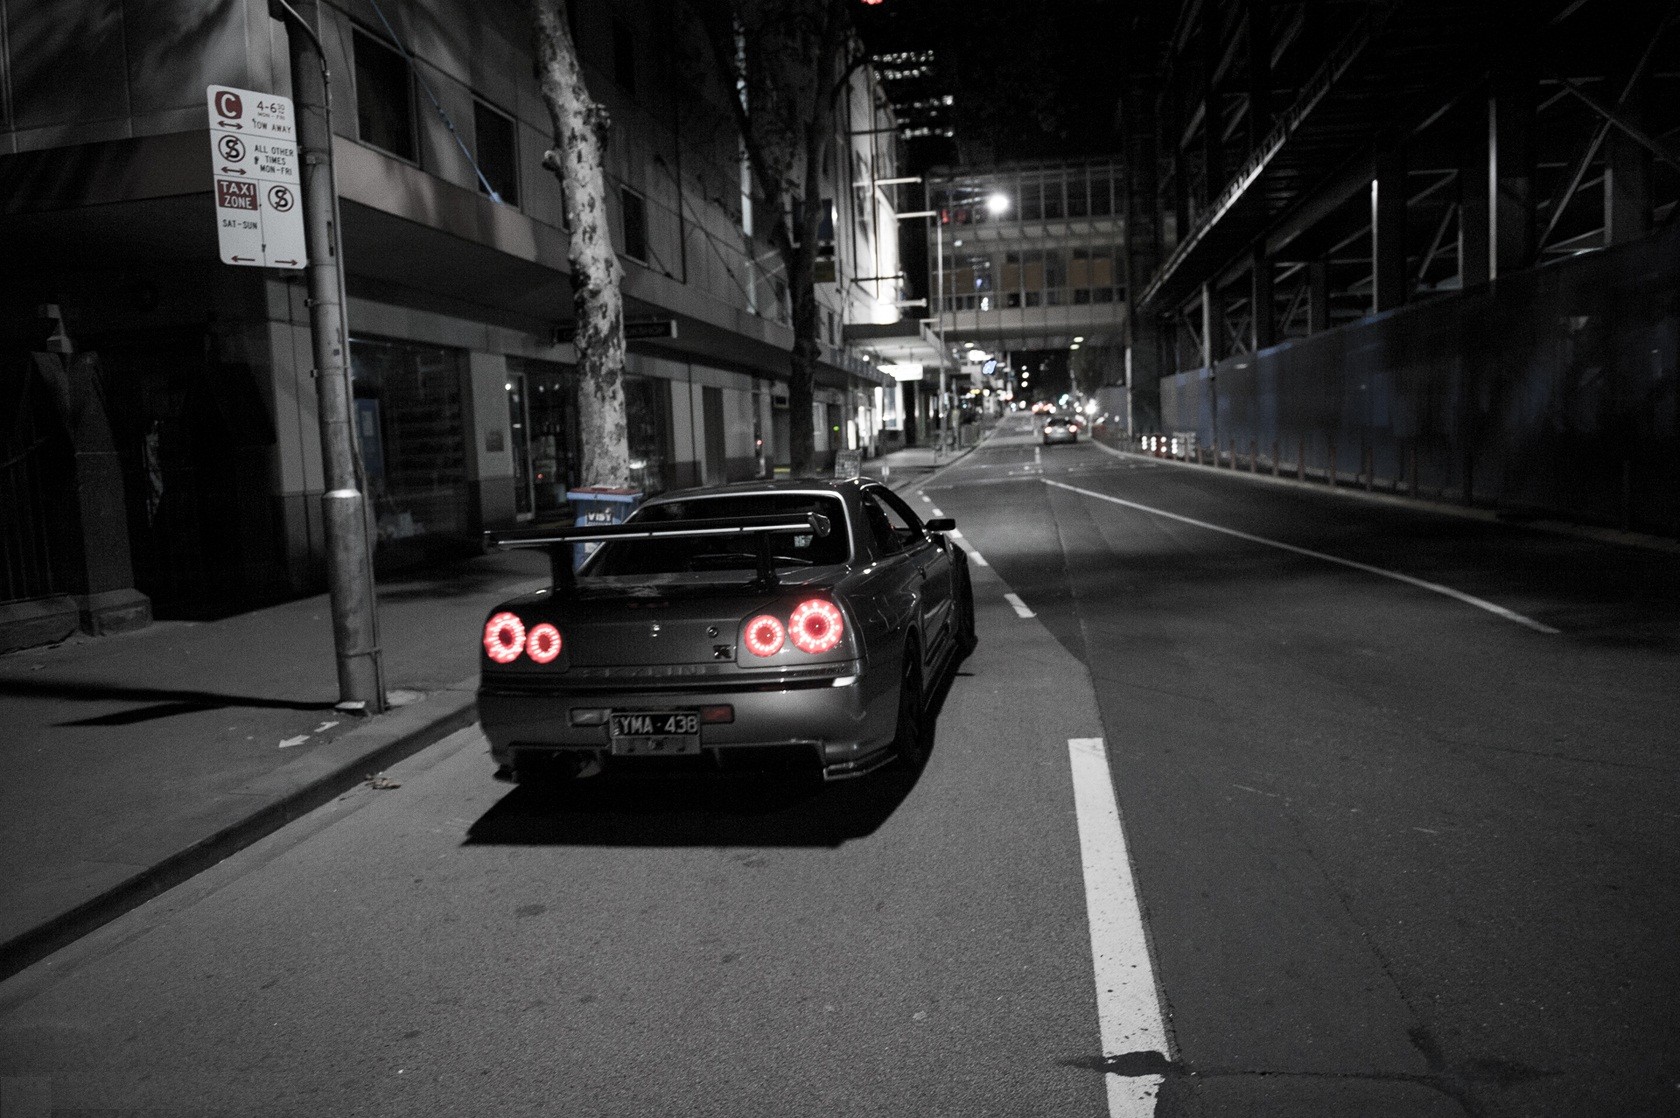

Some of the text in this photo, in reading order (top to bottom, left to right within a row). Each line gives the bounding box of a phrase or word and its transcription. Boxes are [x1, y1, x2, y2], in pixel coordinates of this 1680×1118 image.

[220, 93, 237, 118] C
[252, 119, 292, 134] TOW AWAY
[254, 145, 294, 157] ALL OTHER
[265, 155, 286, 166] TIMES
[220, 181, 255, 196] TAXI
[223, 195, 253, 209] ZONE
